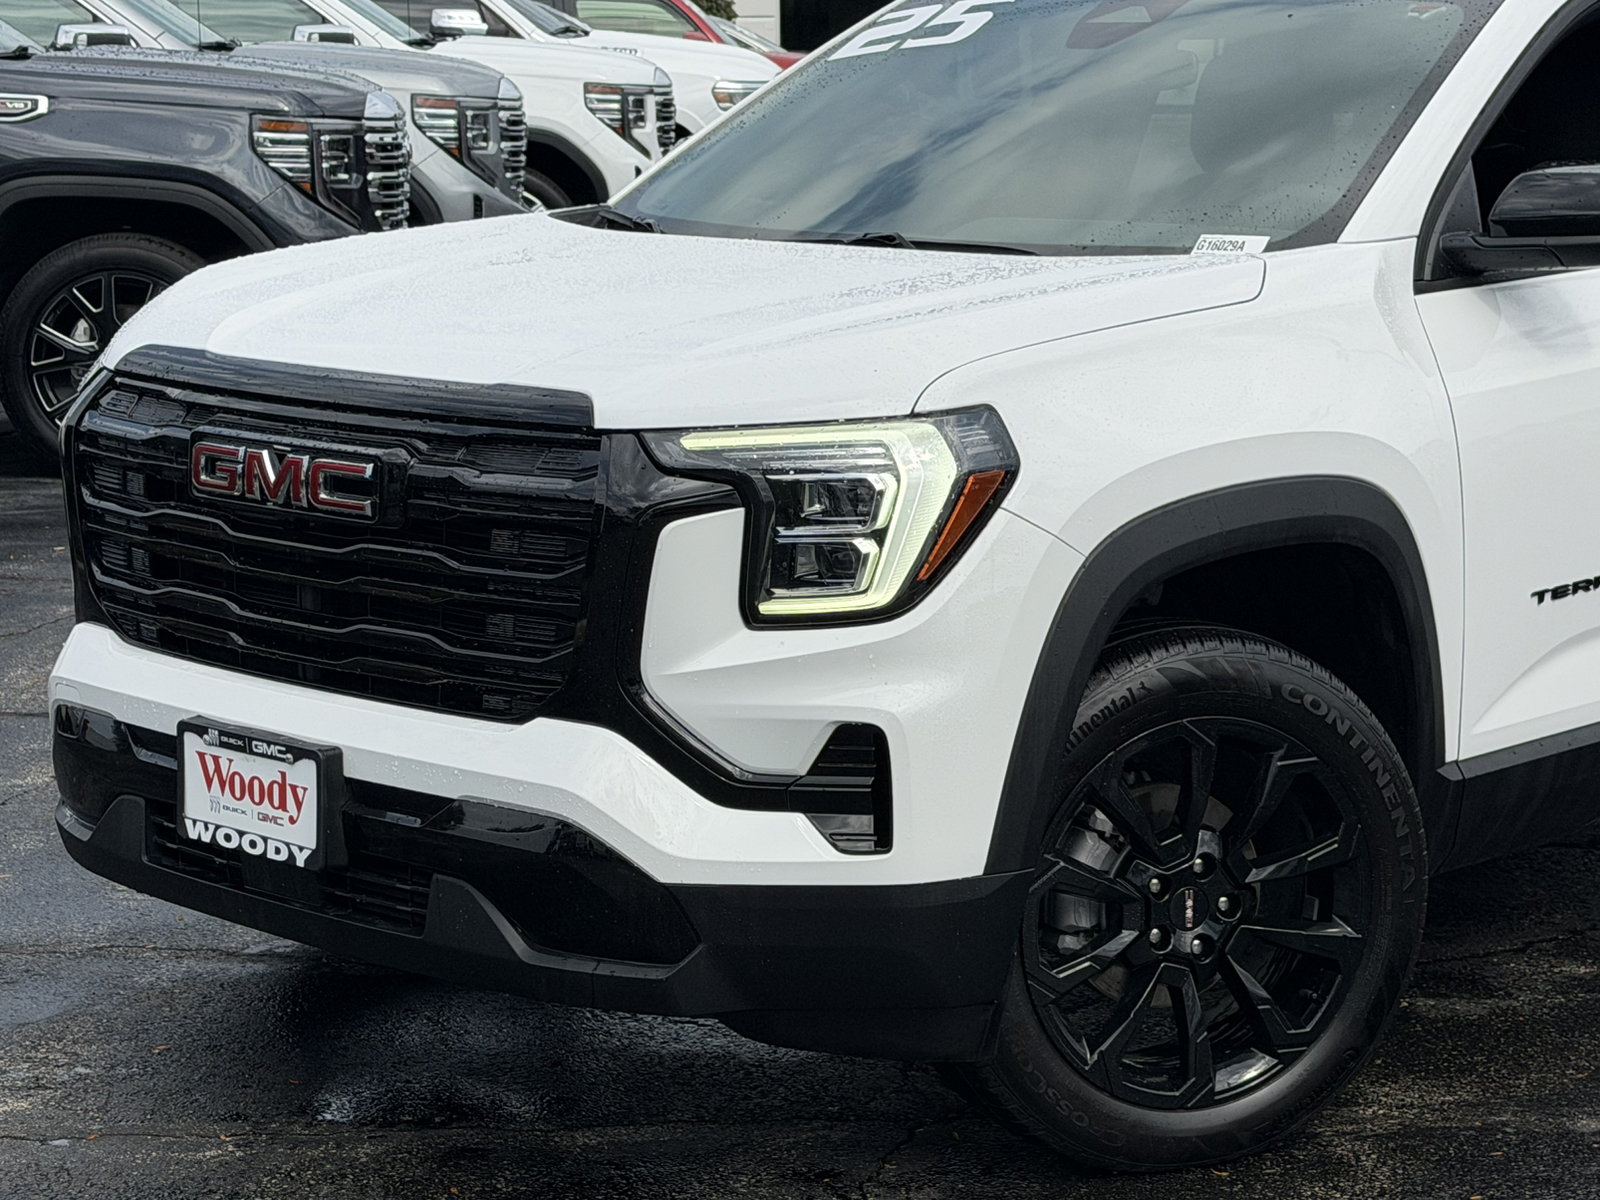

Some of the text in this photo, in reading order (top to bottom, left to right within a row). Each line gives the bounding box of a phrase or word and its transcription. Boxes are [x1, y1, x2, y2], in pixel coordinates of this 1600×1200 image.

[827, 0, 1015, 61] 25
[1196, 239, 1246, 252] G16029A
[192, 441, 374, 517] GMC
[220, 735, 287, 759] BUICK GMC
[194, 750, 309, 826] Woody
[222, 804, 285, 827] BUICK GMC
[184, 817, 313, 868] WOODY
